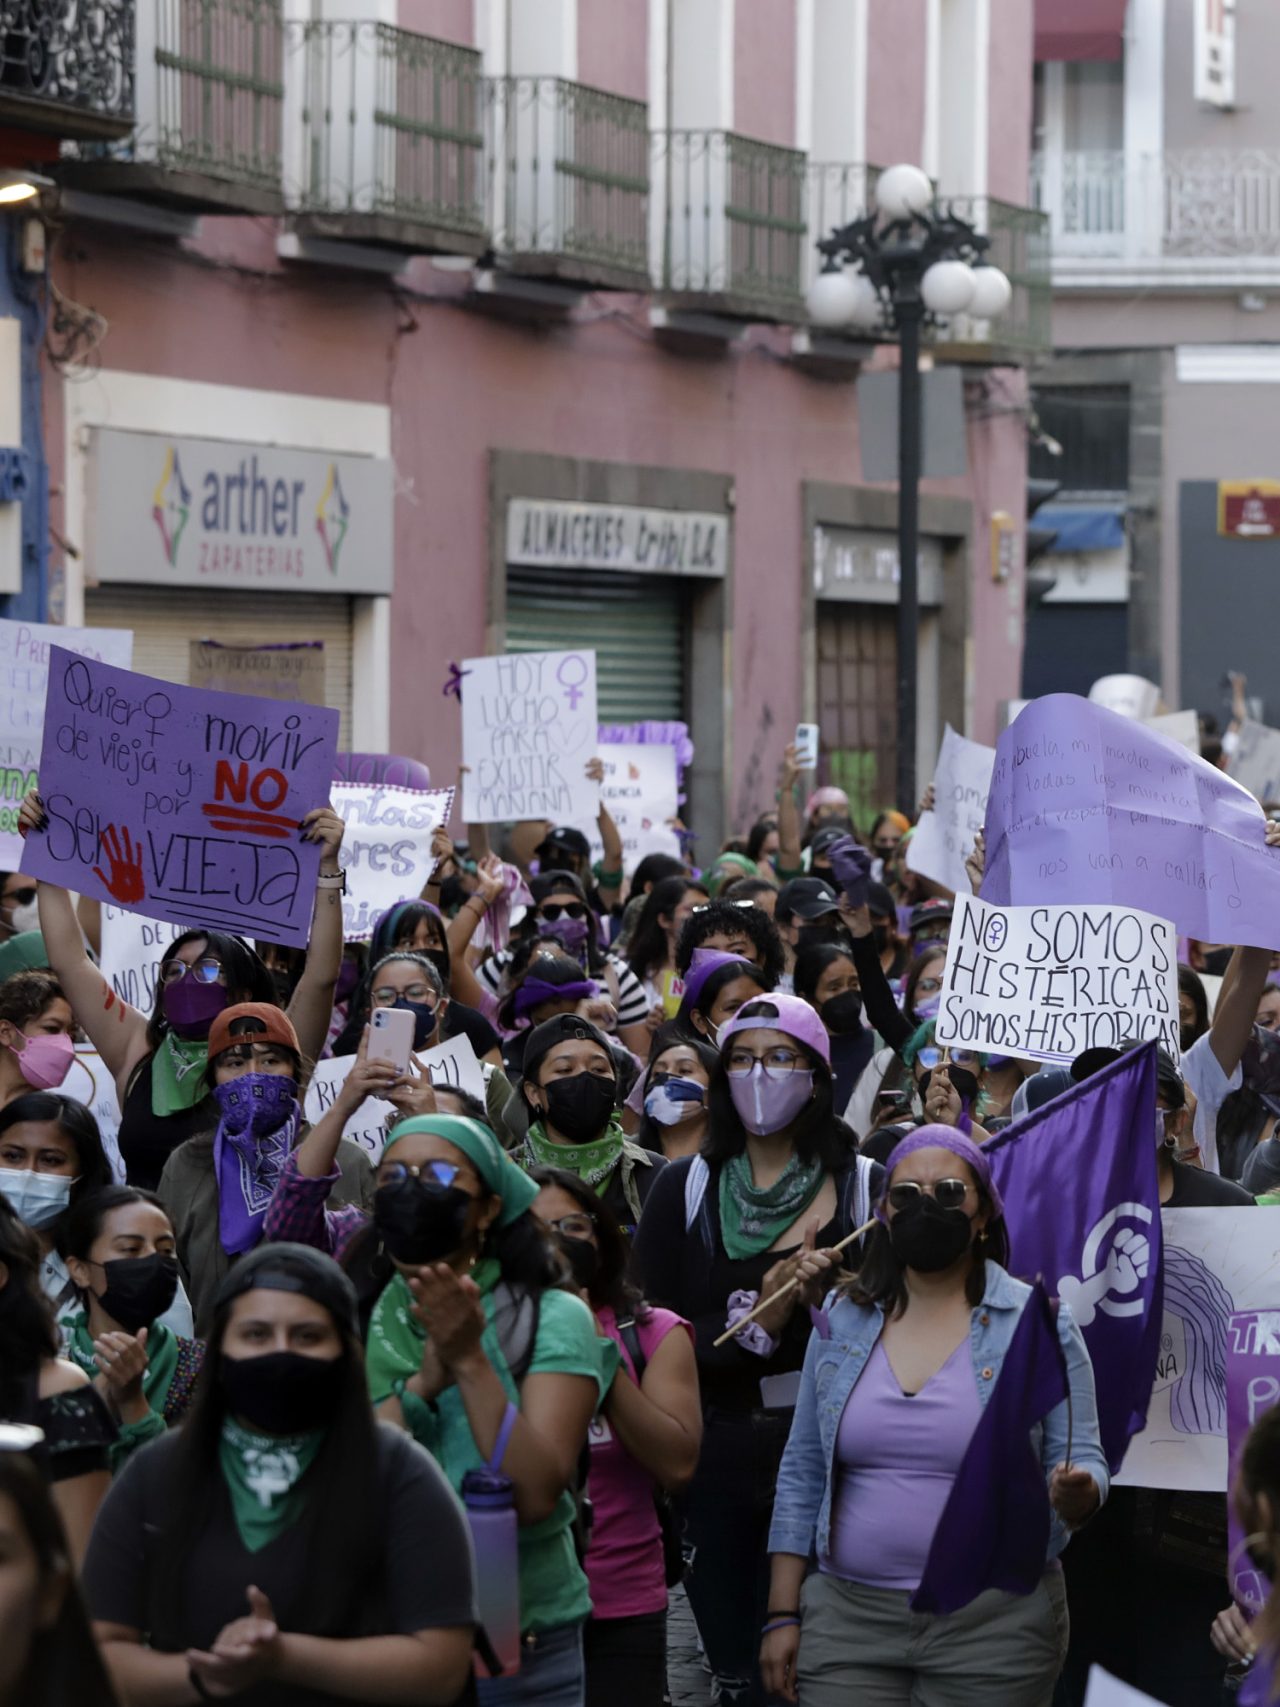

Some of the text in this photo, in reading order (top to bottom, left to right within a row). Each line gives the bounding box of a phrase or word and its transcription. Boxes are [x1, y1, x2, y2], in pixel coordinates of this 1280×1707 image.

[202, 452, 304, 537] arther
[198, 541, 304, 578] ZAPATERIAS
[497, 656, 547, 695] HOY
[481, 694, 559, 728] LUCHO
[205, 715, 324, 770] morir
[490, 725, 550, 756] PARA
[56, 714, 89, 762] de
[100, 733, 157, 787] vieja
[172, 758, 192, 797] y
[213, 759, 289, 812] NO
[476, 755, 568, 791] EXISTIR
[143, 791, 189, 824] por
[1039, 858, 1069, 879] nos
[1088, 853, 1124, 872] van
[1135, 855, 1149, 870] a
[141, 924, 164, 946] DE
[960, 901, 1170, 973] NO SOMOS
[950, 945, 1170, 1013] HISTÉRICAS
[939, 995, 1020, 1049] SOMOS
